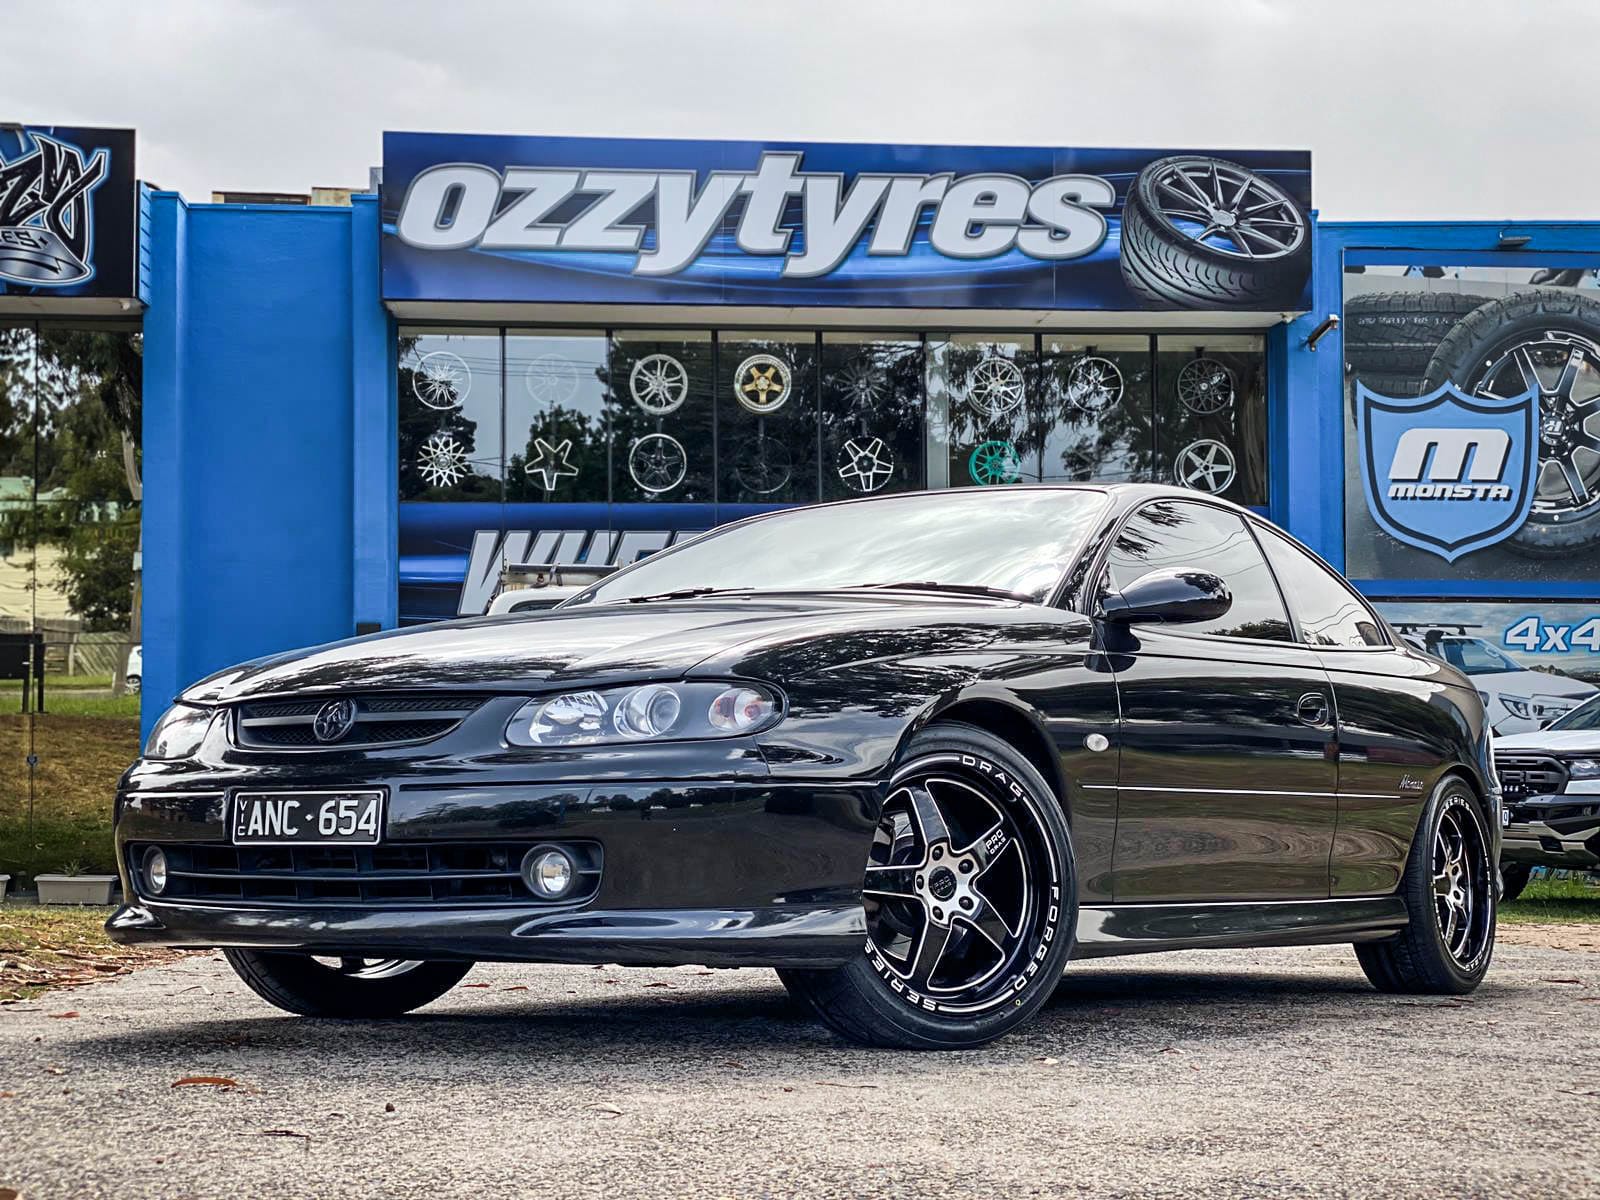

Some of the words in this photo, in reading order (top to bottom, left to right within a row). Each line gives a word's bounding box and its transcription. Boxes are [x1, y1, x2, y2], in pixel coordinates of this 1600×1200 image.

[398, 151, 1116, 278] ozzytyres
[1505, 617, 1600, 652] 4x4
[962, 755, 1024, 799] DRAG
[248, 800, 301, 836] ANC
[318, 800, 378, 836] 654
[985, 829, 1003, 849] PRO
[1013, 885, 1061, 993] FORGED
[864, 938, 937, 1012] SERIES
